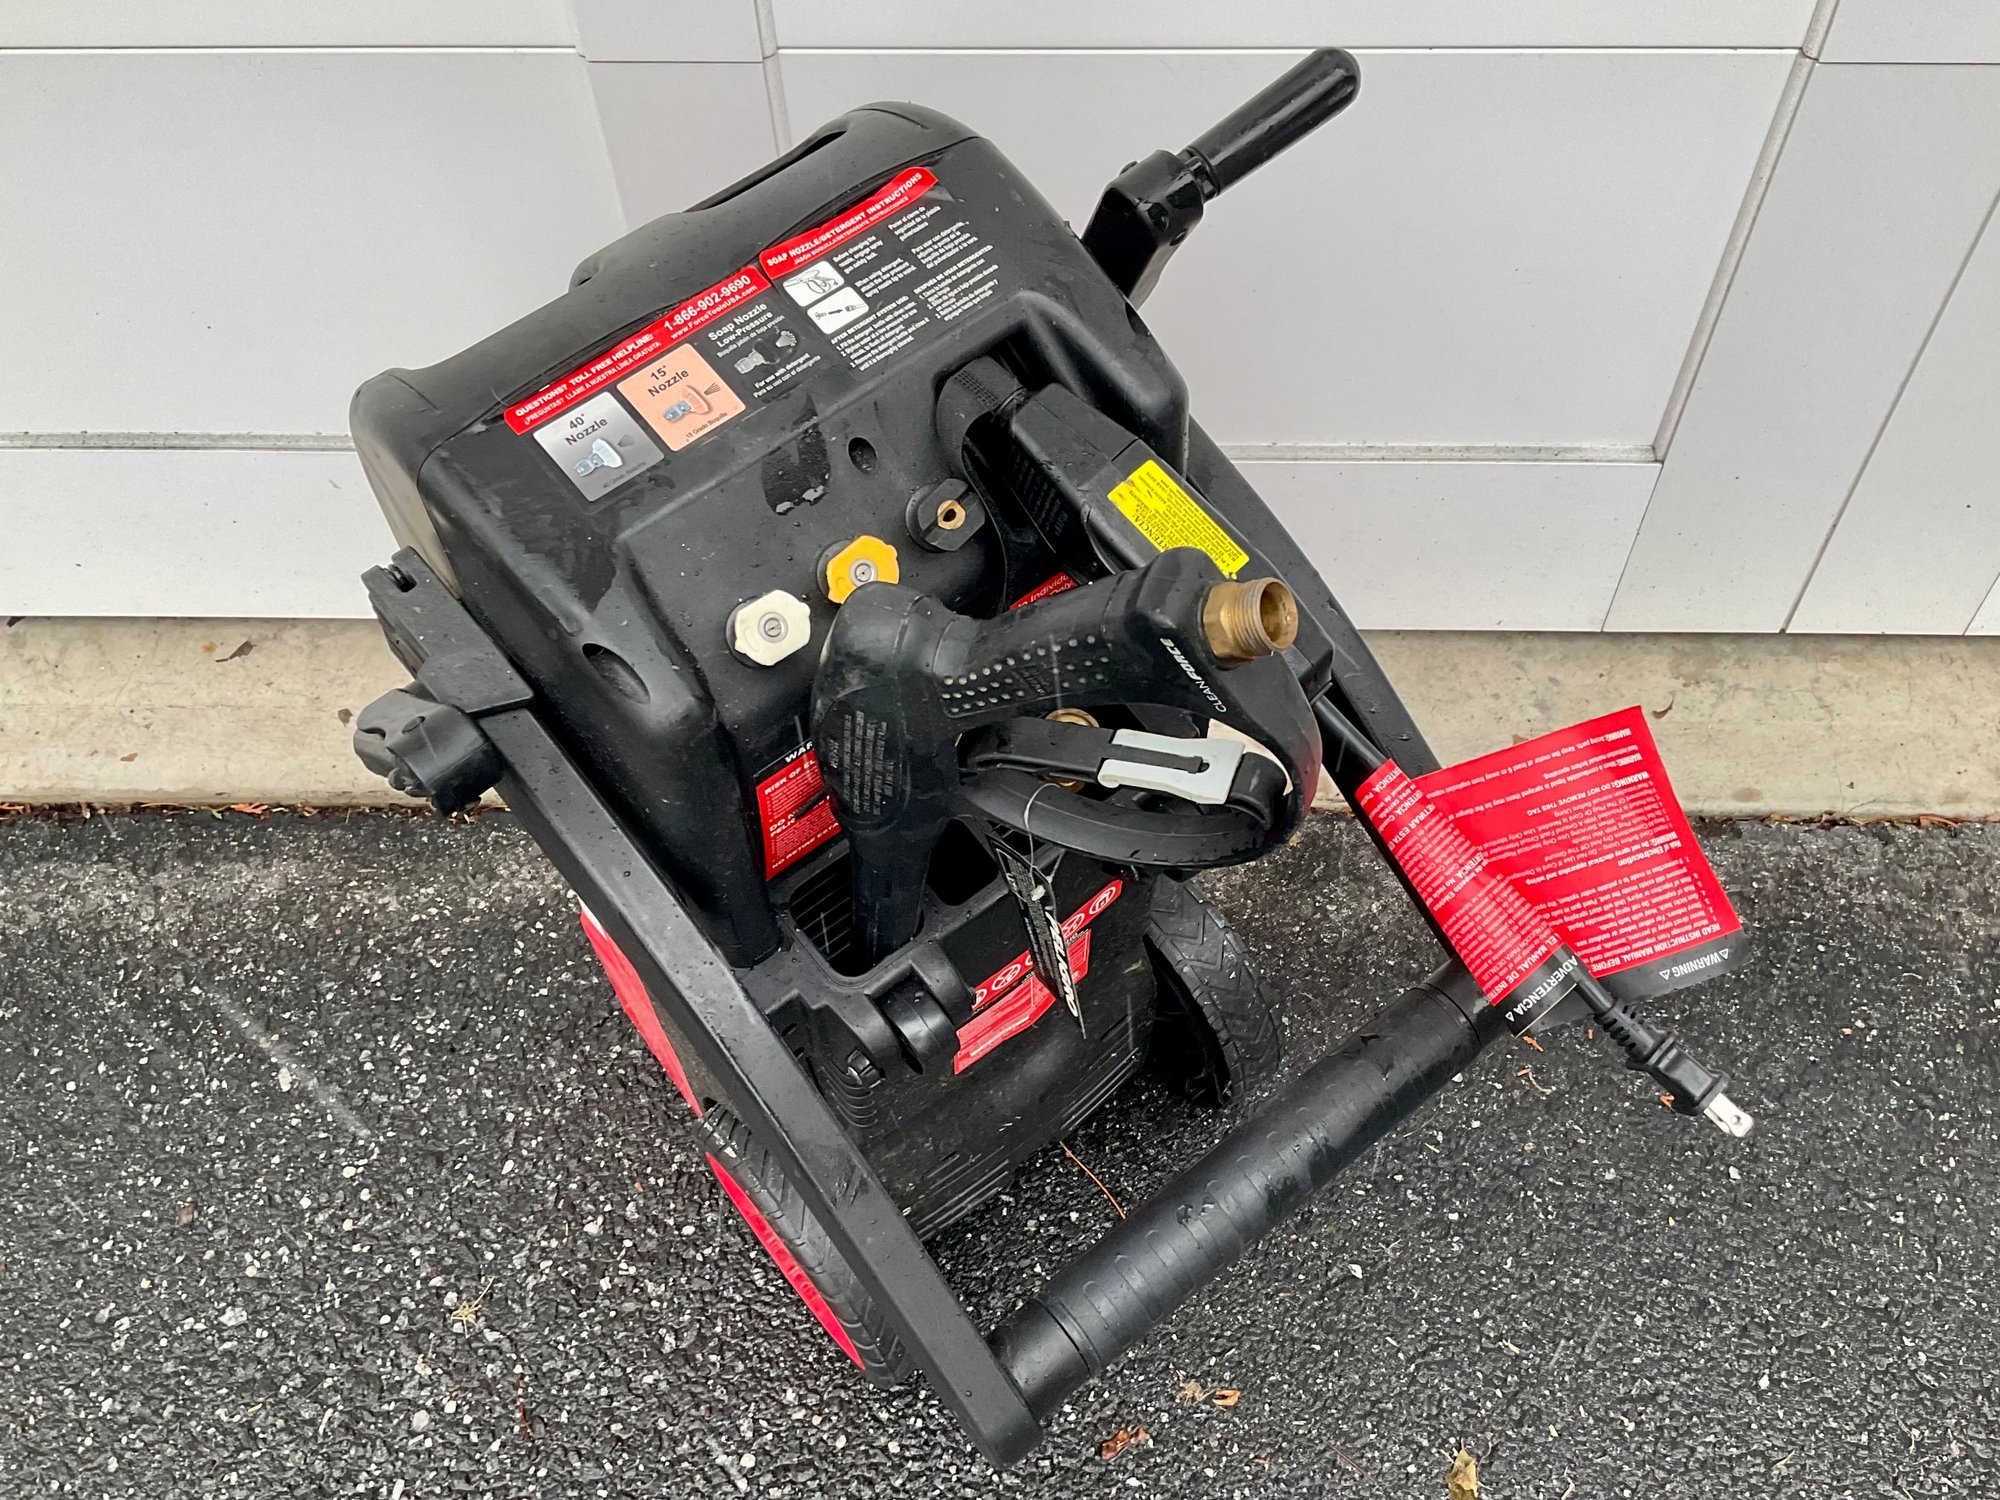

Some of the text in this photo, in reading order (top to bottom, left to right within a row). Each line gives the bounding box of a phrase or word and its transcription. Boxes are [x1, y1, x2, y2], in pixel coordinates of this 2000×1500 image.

[766, 172, 922, 266] SOAP NOZZLE/DETERGENT INSTRUCTIONS
[669, 284, 757, 338] www.ForceToolsUSA.com
[708, 301, 768, 340] Soap Nozzle
[717, 311, 773, 347] Low-Pressure
[516, 274, 751, 416] QUESTIONS? TOLL FREE HELPLINE: 1-866-902-9690
[647, 368, 689, 397] Nozzle
[754, 352, 810, 388] For use with detergent
[565, 416, 608, 445] Nozzle
[1130, 512, 1169, 551] RTENCIA:
[1159, 635, 1227, 713] CLEANFORCE
[765, 776, 786, 795] RISK
[789, 766, 801, 779] OF
[1586, 786, 1600, 796] NOT
[1610, 770, 1649, 787] WARNING:
[1526, 806, 1540, 816] TAG
[1541, 801, 1556, 811] THIS
[1557, 791, 1586, 805] REMOVE
[770, 818, 784, 831] DO
[1392, 826, 1410, 844] ESTA
[772, 857, 783, 868] NO
[1474, 865, 1483, 873] de
[1617, 845, 1663, 866] Electrocution
[1444, 877, 1455, 887] No
[1453, 871, 1476, 893] Impacto
[1591, 923, 1720, 971] READ INSTRUCTION MANUAL BEFORE
[1044, 912, 1077, 1015] PELIGRO
[1486, 935, 1557, 1000] EL MANUAL DE INSTR
[1671, 952, 1720, 976] WARNING
[1512, 956, 1578, 1016] ADVERTENCIA
